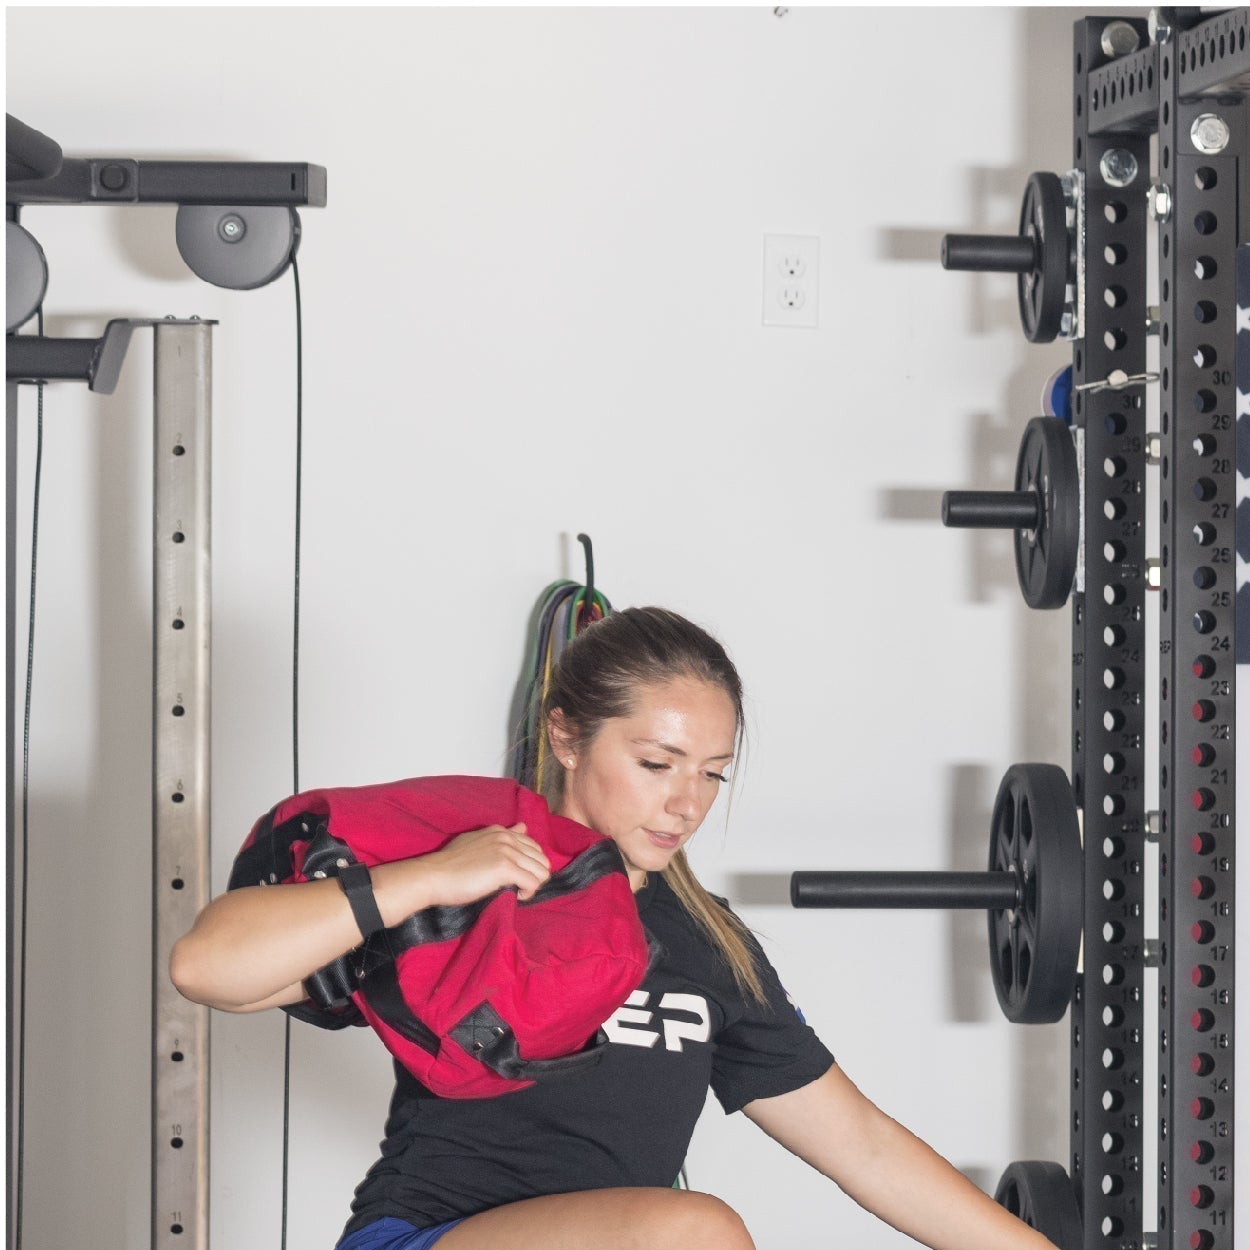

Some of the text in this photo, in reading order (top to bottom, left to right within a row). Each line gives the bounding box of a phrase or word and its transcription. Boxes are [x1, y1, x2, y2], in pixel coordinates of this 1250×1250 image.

[1213, 370, 1231, 385] 30
[1212, 459, 1230, 474] 28
[1212, 503, 1230, 518] 27
[1212, 592, 1230, 607] 25
[1212, 636, 1230, 651] 24
[1212, 680, 1229, 696] 23
[1212, 725, 1229, 740] 22
[1211, 769, 1229, 784] 21
[1211, 813, 1229, 828] 20
[1211, 901, 1228, 917] 18
[1211, 945, 1228, 961] 17
[601, 990, 711, 1052] EP
[1211, 1034, 1228, 1049] 15
[1210, 1078, 1228, 1093] 14
[172, 1125, 181, 1135] 10
[1210, 1122, 1227, 1137] 13
[1210, 1166, 1227, 1181] 12
[172, 1212, 181, 1221] 11
[1210, 1210, 1227, 1225] 11
